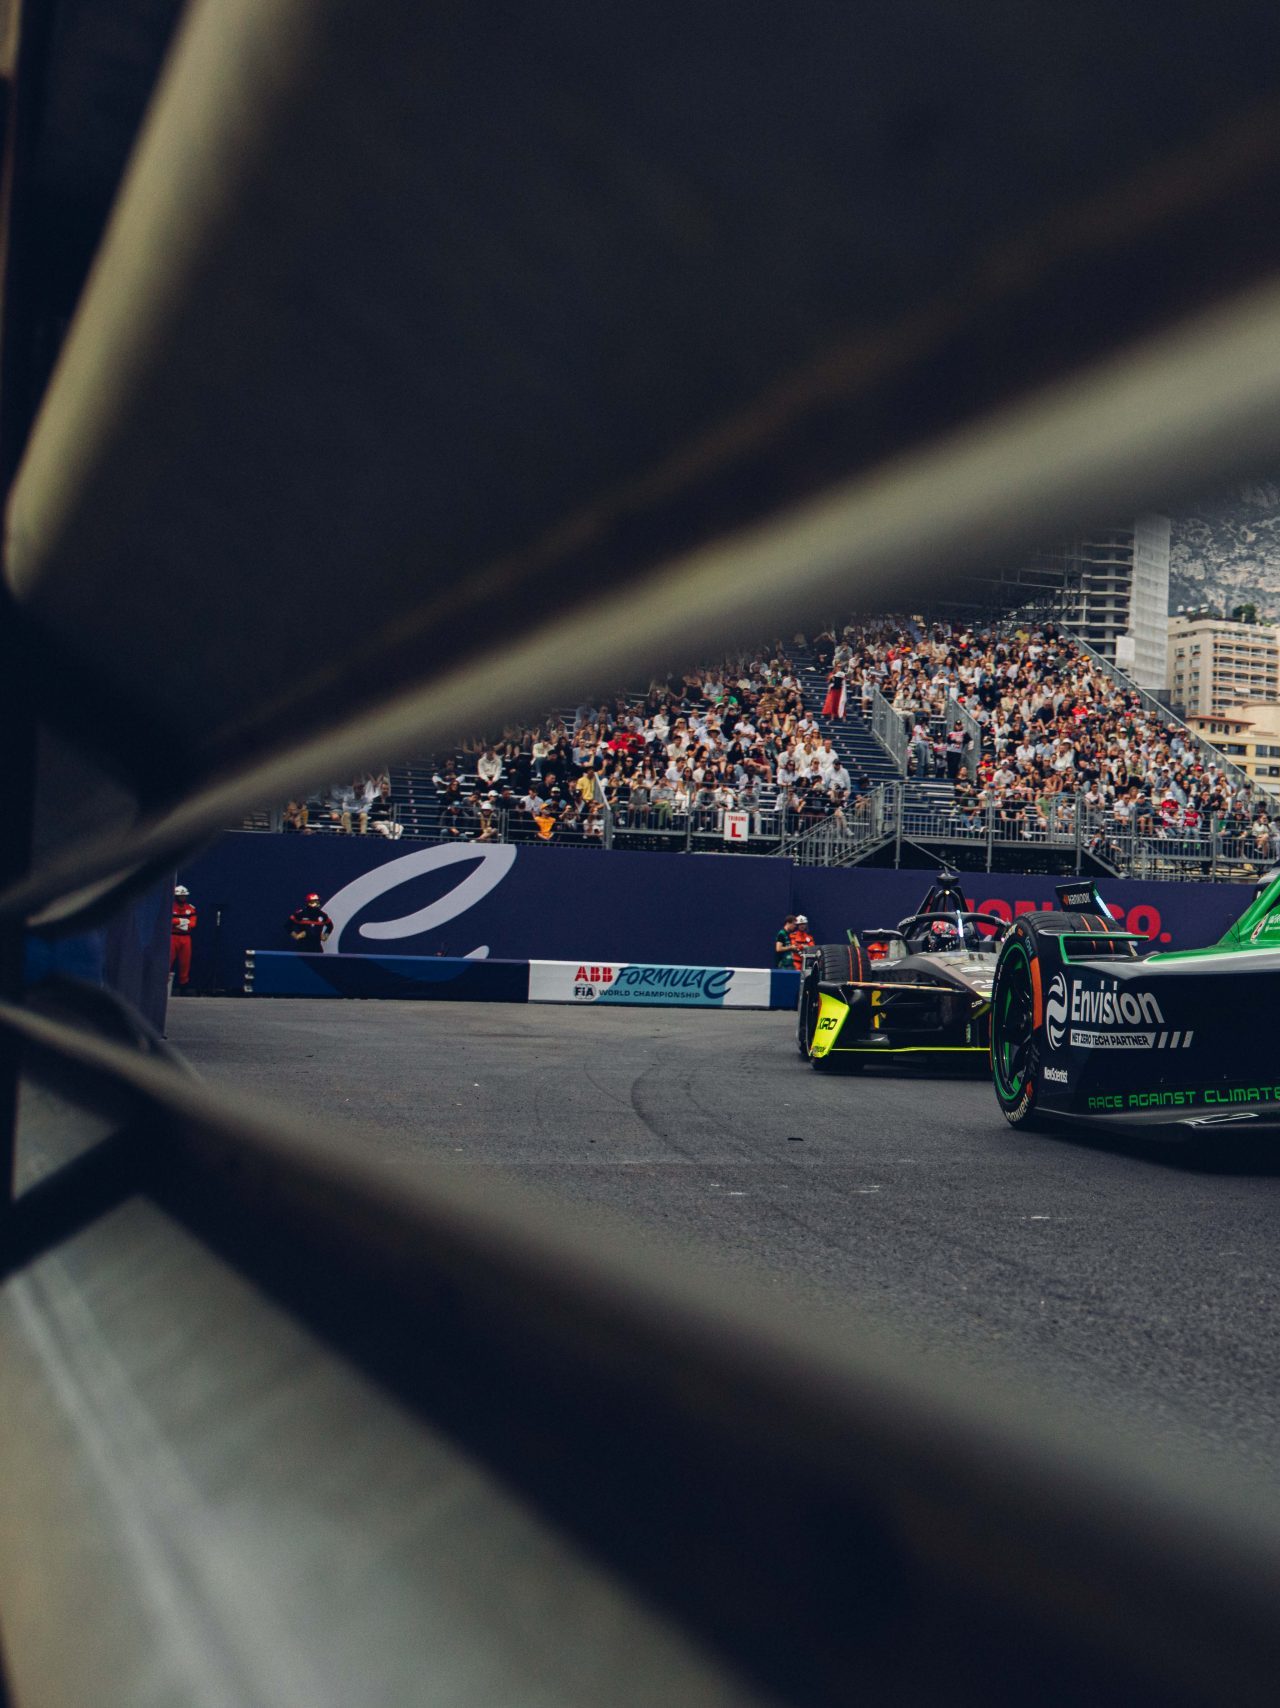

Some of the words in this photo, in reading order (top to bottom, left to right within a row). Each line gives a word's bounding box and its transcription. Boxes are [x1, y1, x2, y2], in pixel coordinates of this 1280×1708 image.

[731, 823, 742, 838] L
[574, 966, 613, 983] ABB
[634, 990, 701, 999] CHAMPIONSHIP
[1071, 980, 1165, 1024] Envision
[1072, 1031, 1081, 1042] NET
[1080, 1033, 1092, 1043] ZERO
[1092, 1034, 1110, 1045] TECH
[1111, 1035, 1150, 1046] PARTNER
[1088, 1095, 1123, 1109] RACE
[1129, 1090, 1197, 1106] AGAINST
